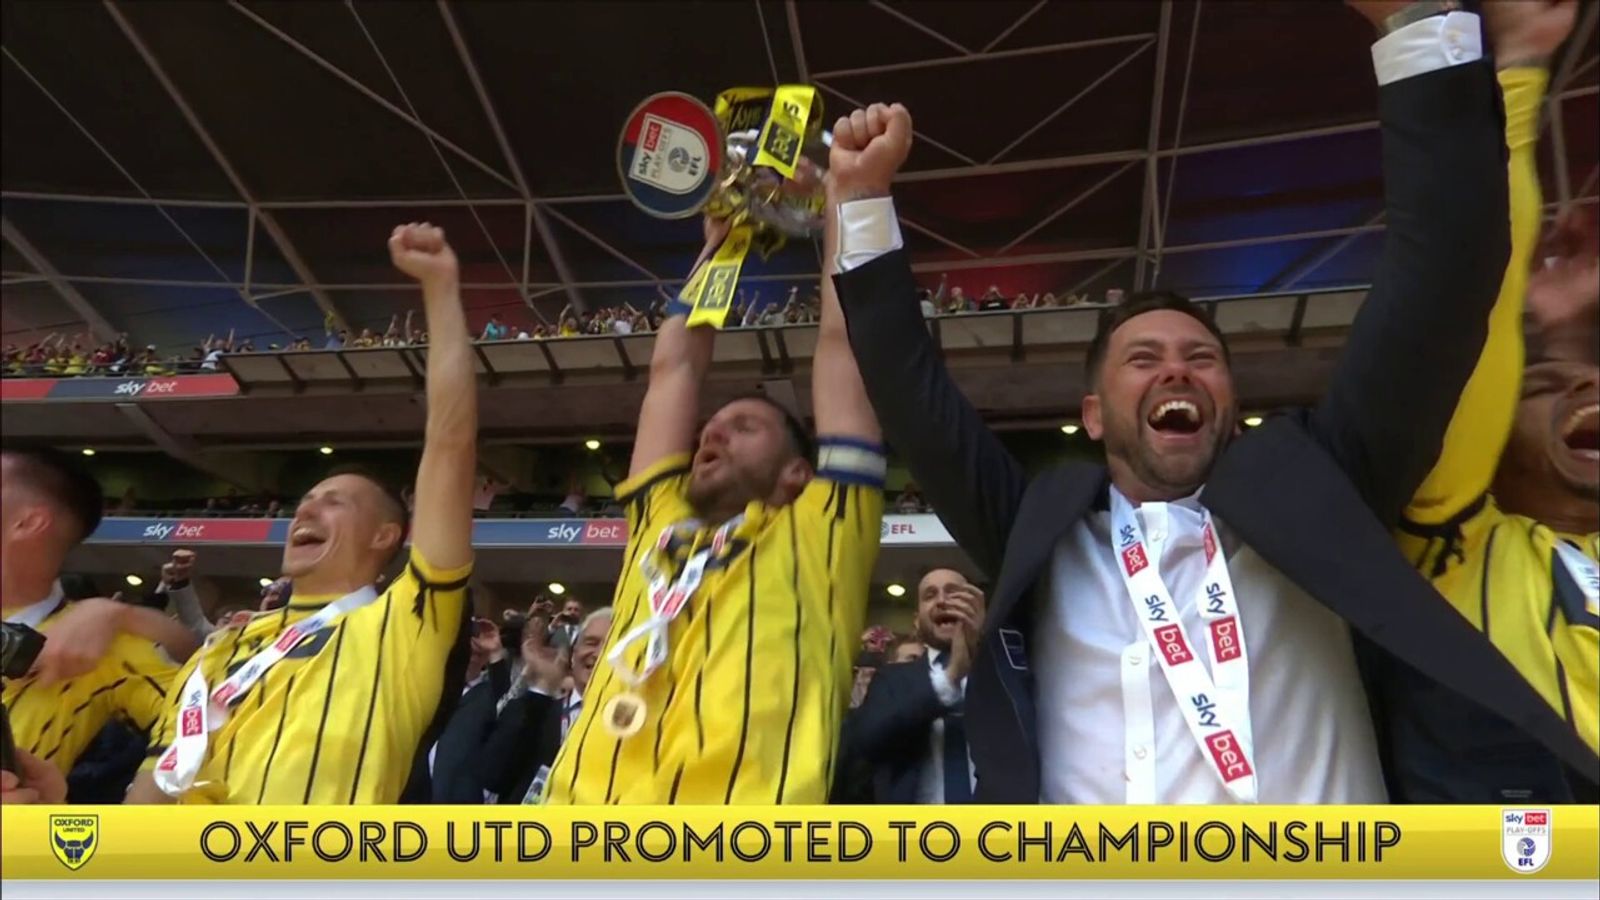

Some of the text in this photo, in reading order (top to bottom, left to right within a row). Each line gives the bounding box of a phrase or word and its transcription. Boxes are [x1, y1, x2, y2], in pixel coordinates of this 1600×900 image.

[638, 123, 660, 175] sky bet
[688, 156, 702, 176] EFL
[114, 380, 178, 395] sky bet
[143, 522, 204, 540] sky bet
[547, 523, 620, 542] sky bet
[891, 524, 916, 535] EFL
[1120, 524, 1145, 573] sky bet
[1145, 594, 1188, 661] sky bet
[1206, 582, 1226, 615] sky
[1216, 621, 1238, 658] bet
[1191, 693, 1245, 777] sky bet
